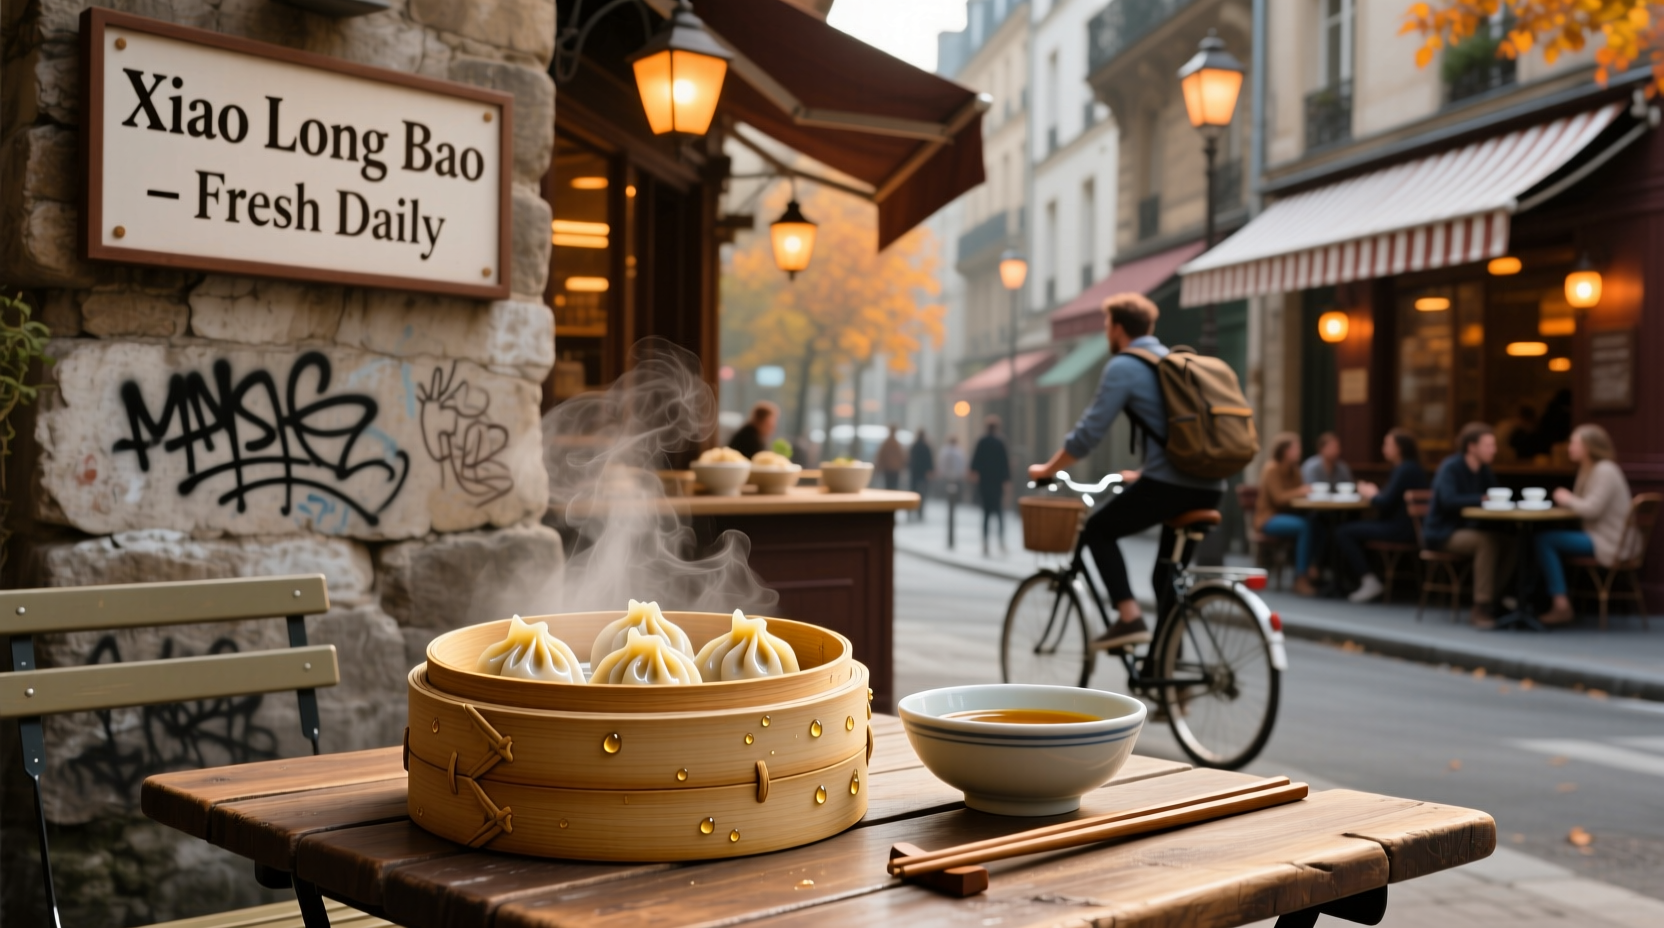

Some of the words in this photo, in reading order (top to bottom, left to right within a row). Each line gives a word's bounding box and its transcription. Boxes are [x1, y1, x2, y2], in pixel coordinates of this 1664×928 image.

[122, 67, 249, 144] Xiao
[264, 95, 389, 183] Long
[401, 120, 485, 182] Bao
[194, 170, 321, 232] Fresh
[335, 190, 446, 260] Daily
